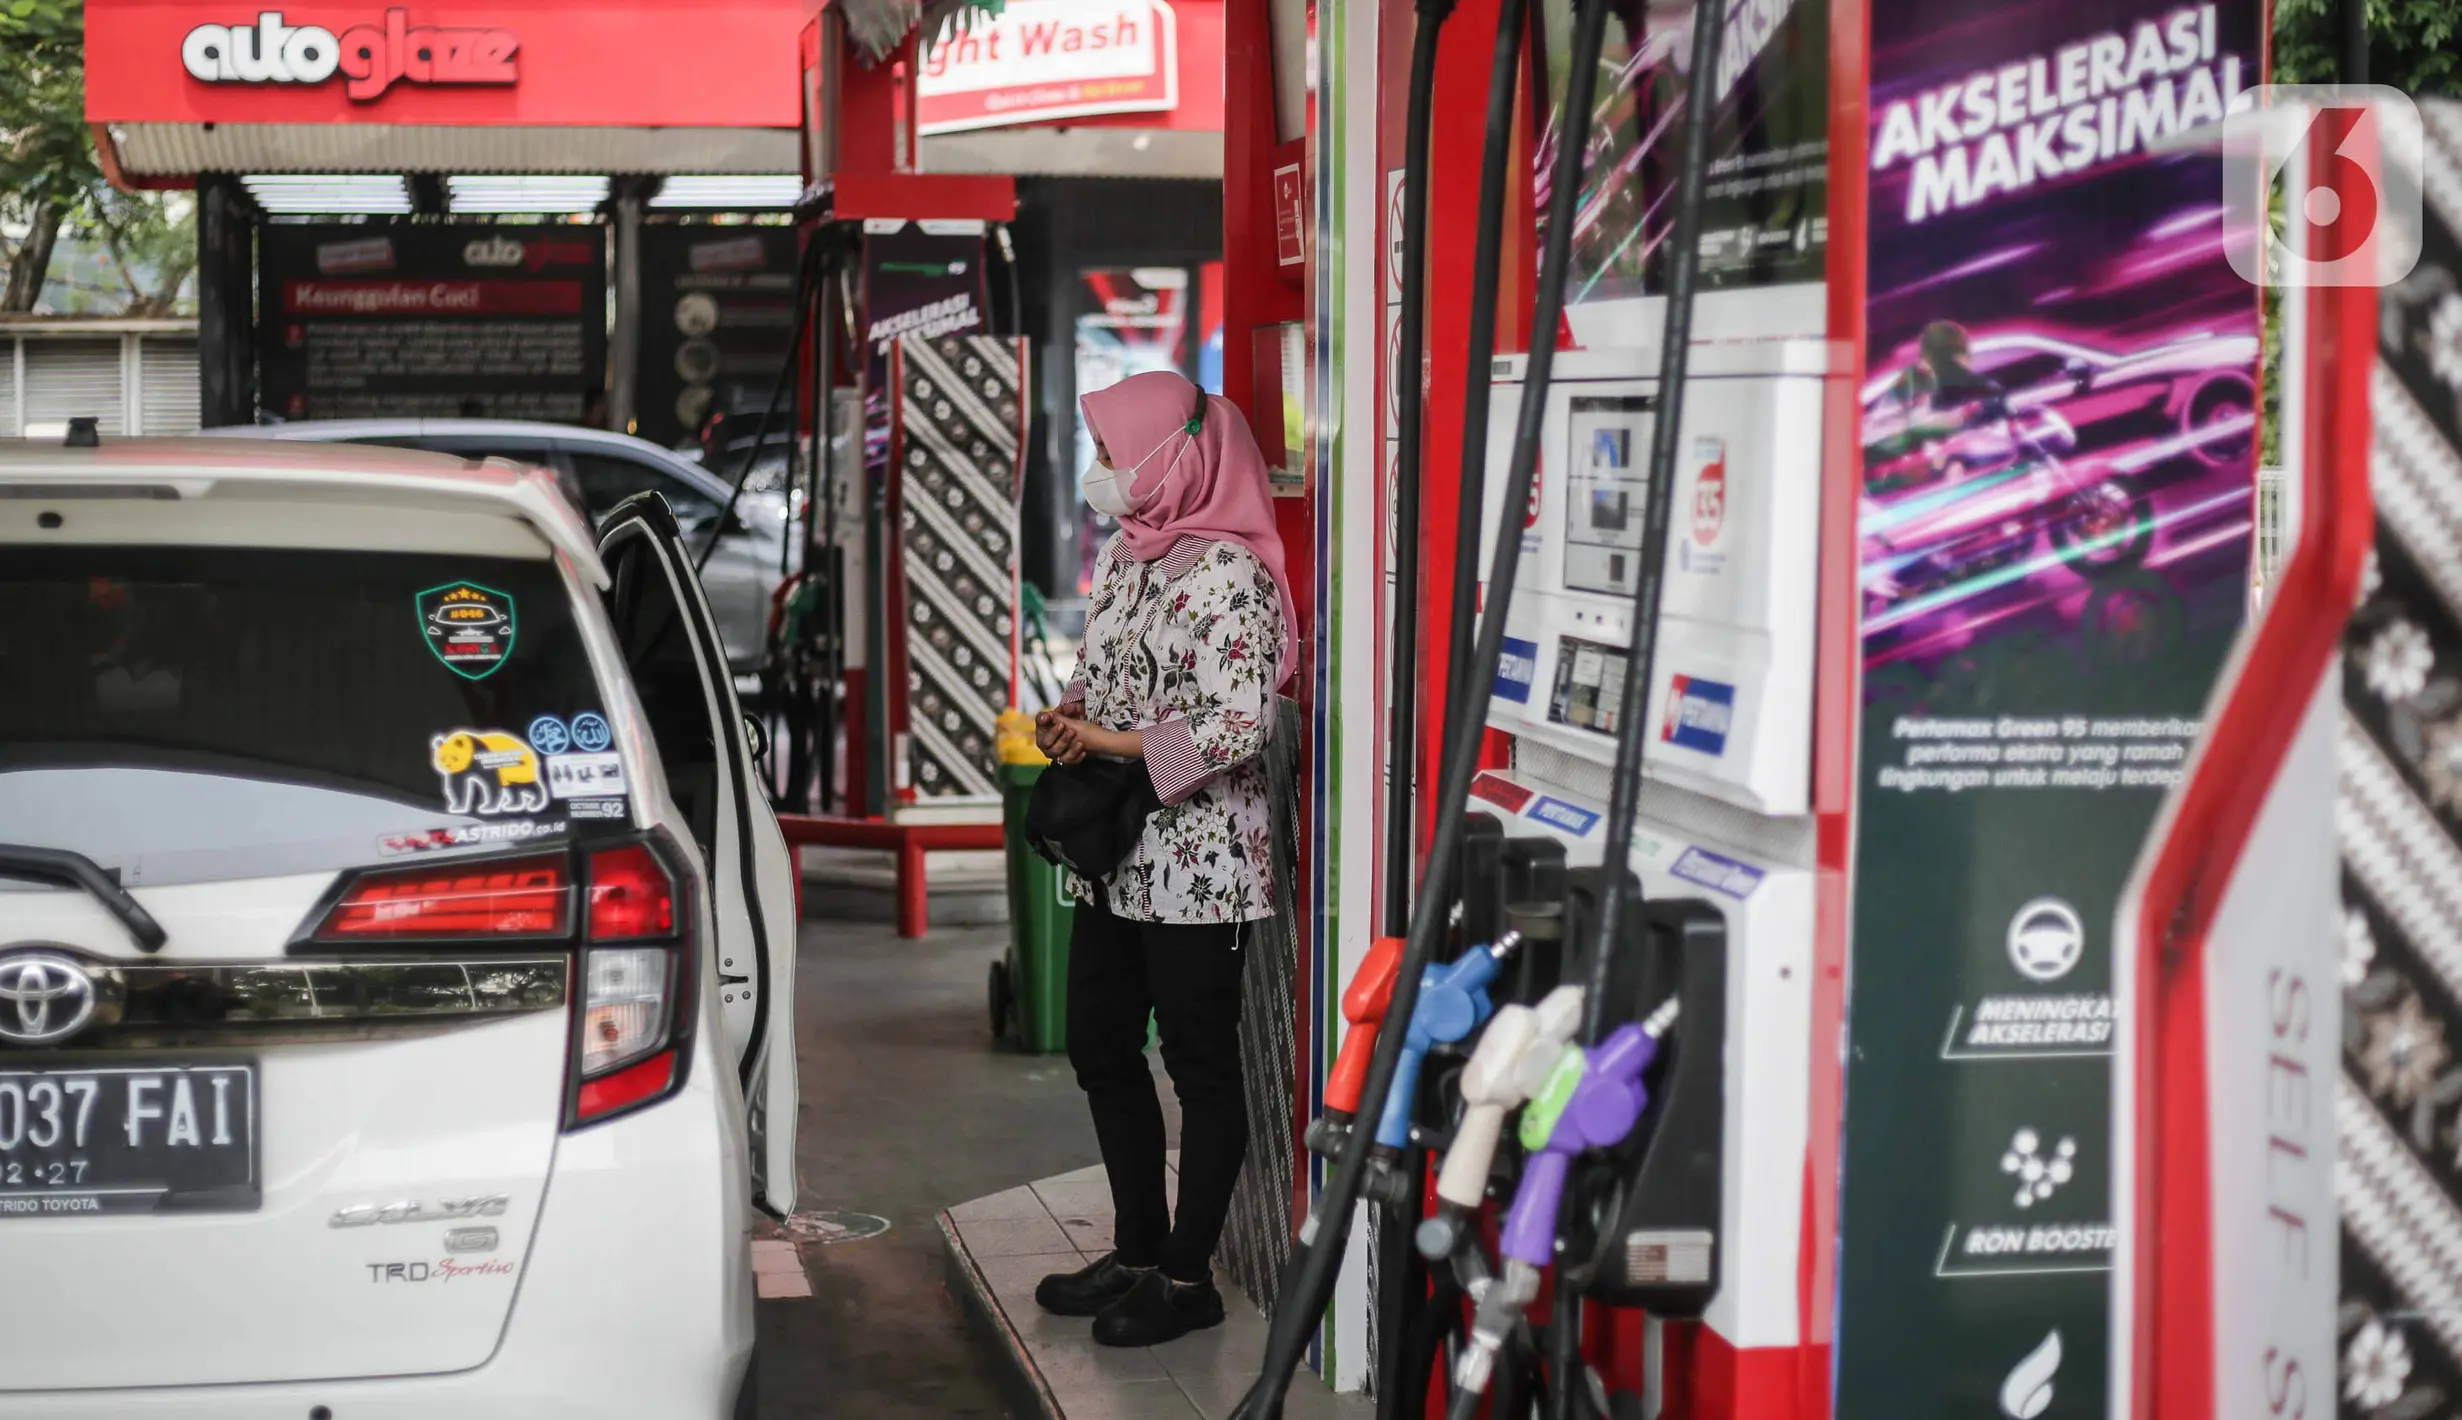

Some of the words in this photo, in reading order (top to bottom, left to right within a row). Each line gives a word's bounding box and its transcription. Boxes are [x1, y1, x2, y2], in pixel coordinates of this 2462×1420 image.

[1020, 14, 1138, 56] Wash
[181, 7, 521, 104] autoglaze
[1872, 4, 2217, 170] AKSELERASI
[1905, 55, 2253, 224] MAKSIMAL
[295, 283, 425, 311] Keunggulan
[429, 283, 480, 308] Cuci
[1893, 717, 1993, 738] Pertamax
[1996, 717, 2058, 738] Green
[2062, 717, 2088, 738] 95
[1906, 744, 2000, 766] performa
[2004, 744, 2064, 763] ekstra
[2067, 746, 2119, 767] yang
[2122, 744, 2184, 761] ramah
[1878, 767, 1990, 792] lingkungan
[1993, 767, 2048, 787] untuk
[2051, 767, 2117, 791] melaju
[2120, 767, 2186, 790] terdep
[602, 801, 624, 818] 92
[454, 820, 566, 844] ASTRIDO.co.id
[1968, 1022, 2112, 1044] AKSELERASI
[124, 1077, 232, 1147] FAI
[2264, 967, 2311, 1282] SELF
[41, 1198, 99, 1211] TOYOTA
[1966, 1229, 2025, 1254] RON
[2027, 1227, 2117, 1251] BOOSTE
[366, 1261, 429, 1284] TRD
